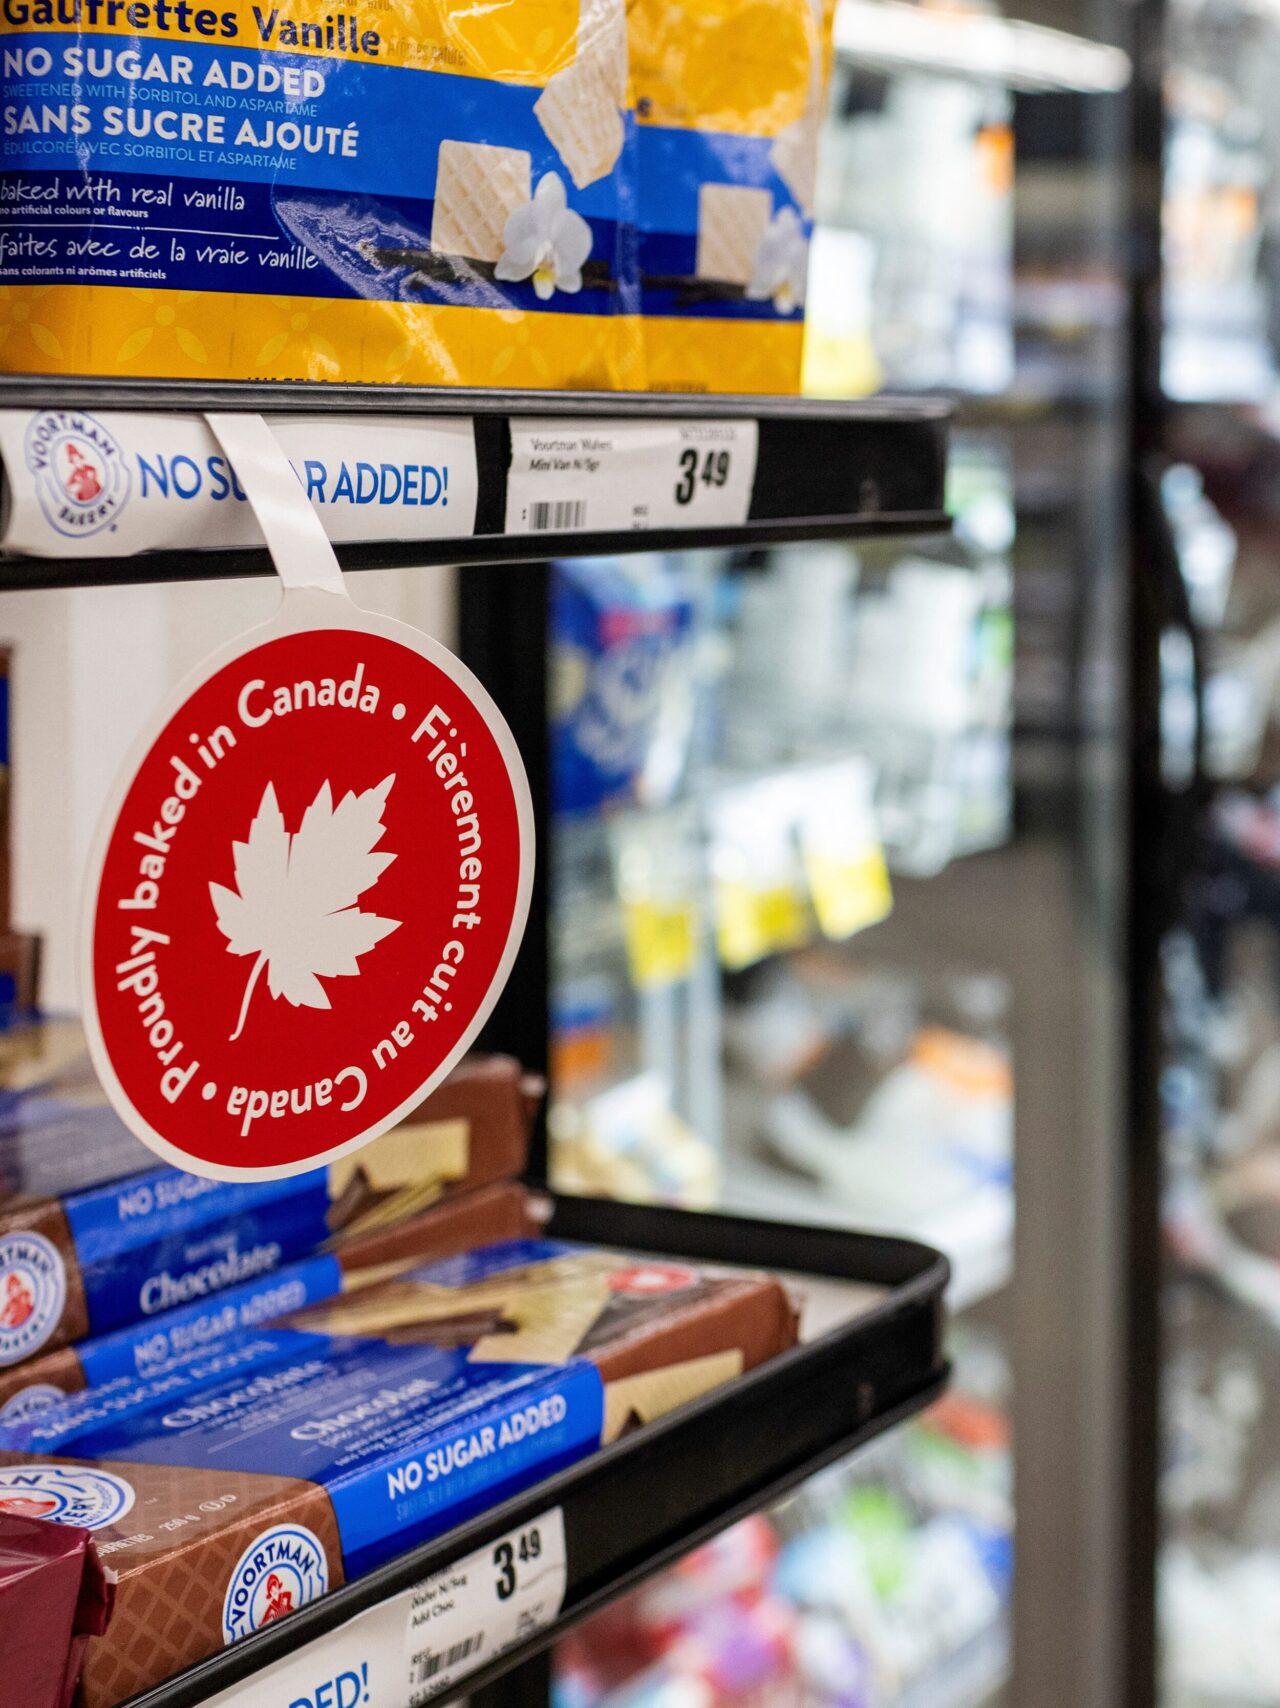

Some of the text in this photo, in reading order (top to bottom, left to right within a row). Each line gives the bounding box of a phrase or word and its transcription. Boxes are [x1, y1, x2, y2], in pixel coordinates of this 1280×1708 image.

[3, 0, 380, 56] Gaufrettes Vanille
[4, 47, 325, 98] NO SUGAR ADDED
[3, 83, 318, 118] SWEETENED WITH SORBITOL AND ASPARTAME
[4, 104, 359, 157] SANS SUCRE AJOUTÉ
[4, 138, 297, 170] ÉDULCORÉ AVEC SORBITOL ET ASPARTAME
[0, 177, 245, 211] baked with real vanilla
[11, 204, 52, 215] artificial
[54, 205, 91, 215] colours
[93, 207, 106, 215] or
[108, 206, 149, 218] flavours
[0, 232, 319, 270] faites avec de la vraie vanille
[0, 265, 167, 280] sans colorants ni arômes artificiels
[136, 453, 202, 500] NO
[330, 461, 448, 506] ADDED!
[676, 448, 730, 505] 3 49
[116, 662, 380, 1104] Proudly baked in Canada
[226, 704, 482, 1137] Fièrement cuit au Canada
[118, 1187, 153, 1220] NO
[140, 1242, 281, 1315] Chocolate
[134, 1333, 168, 1367] NO
[170, 1306, 237, 1350] SUGAR
[387, 1461, 422, 1500] NO
[425, 1426, 496, 1482] SUGAR
[498, 1394, 567, 1449] ADDED
[232, 1539, 315, 1626] VOORTMAN
[493, 1528, 541, 1602] 3 49
[288, 1661, 370, 1708] ED!
